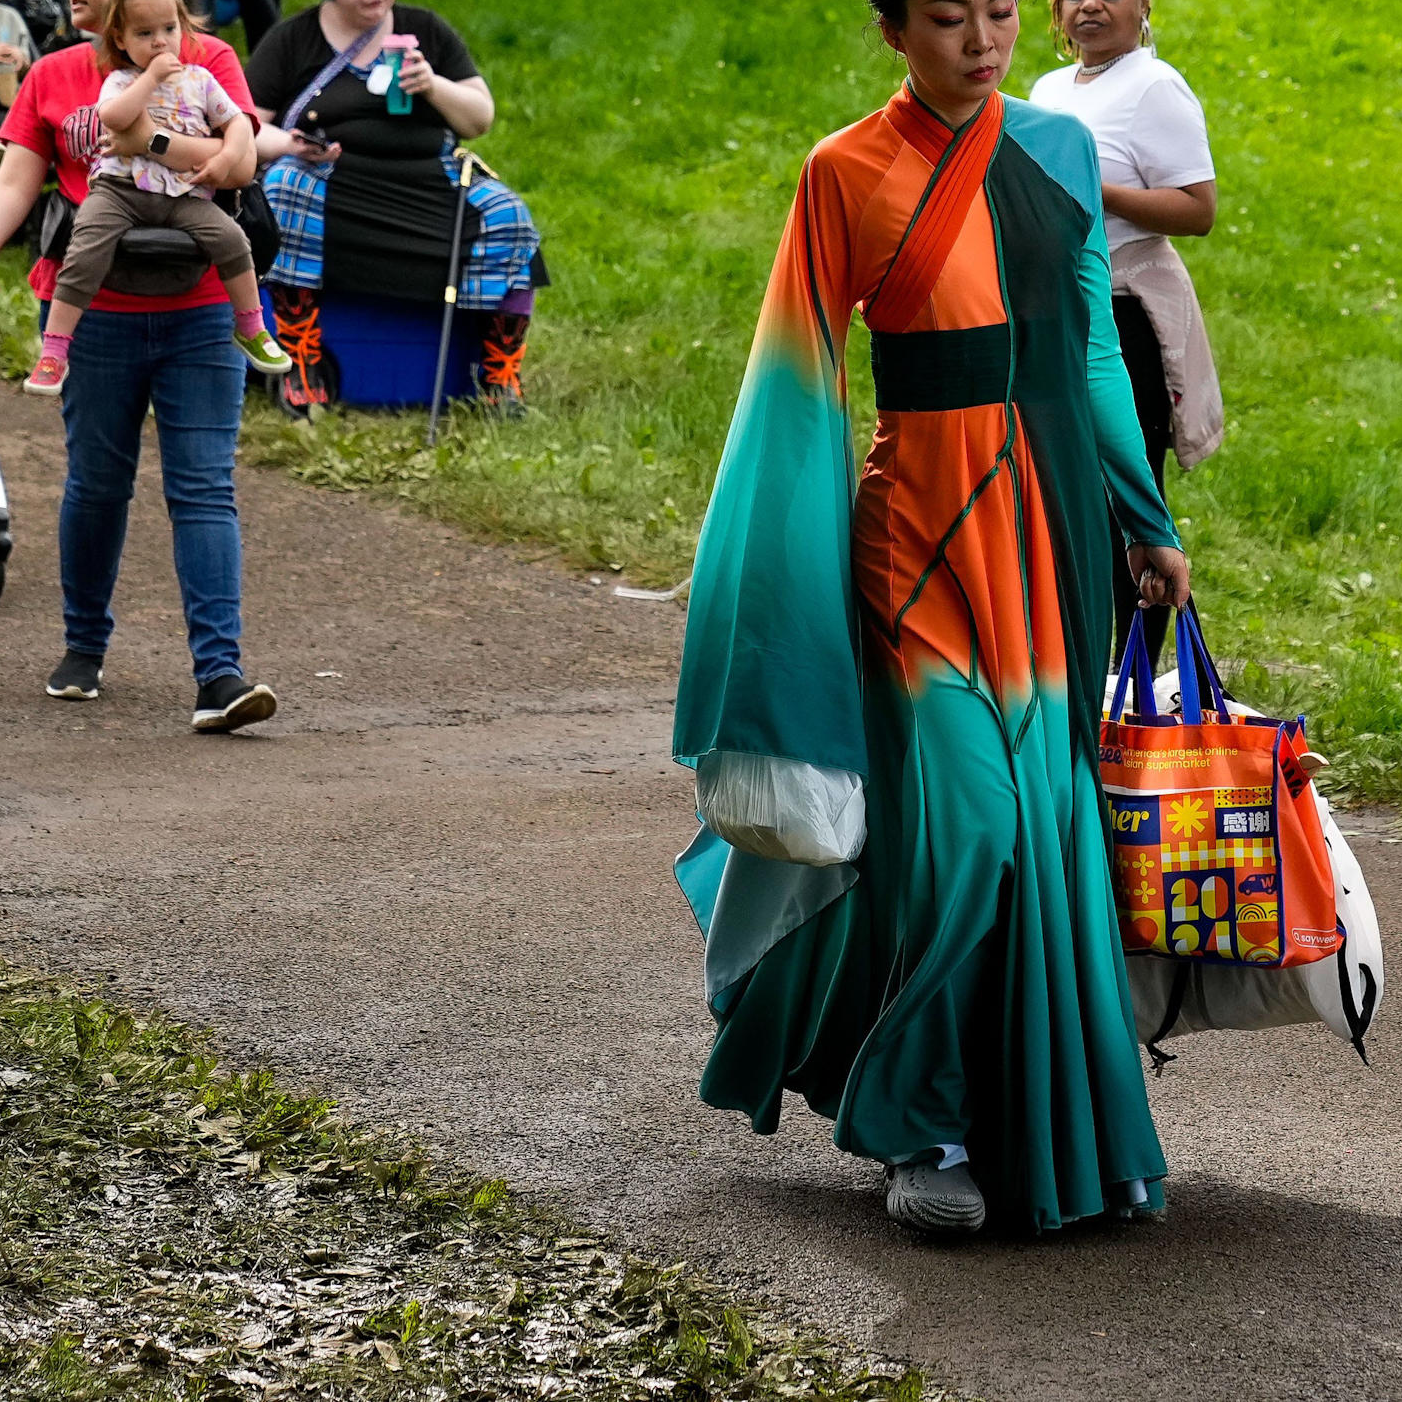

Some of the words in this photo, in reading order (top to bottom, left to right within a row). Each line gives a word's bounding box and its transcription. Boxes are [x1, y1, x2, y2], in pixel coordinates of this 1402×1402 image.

[1168, 747, 1202, 759] largest
[1205, 746, 1238, 756] online
[1147, 758, 1211, 772] supermarket
[1223, 811, 1271, 833] 感谢
